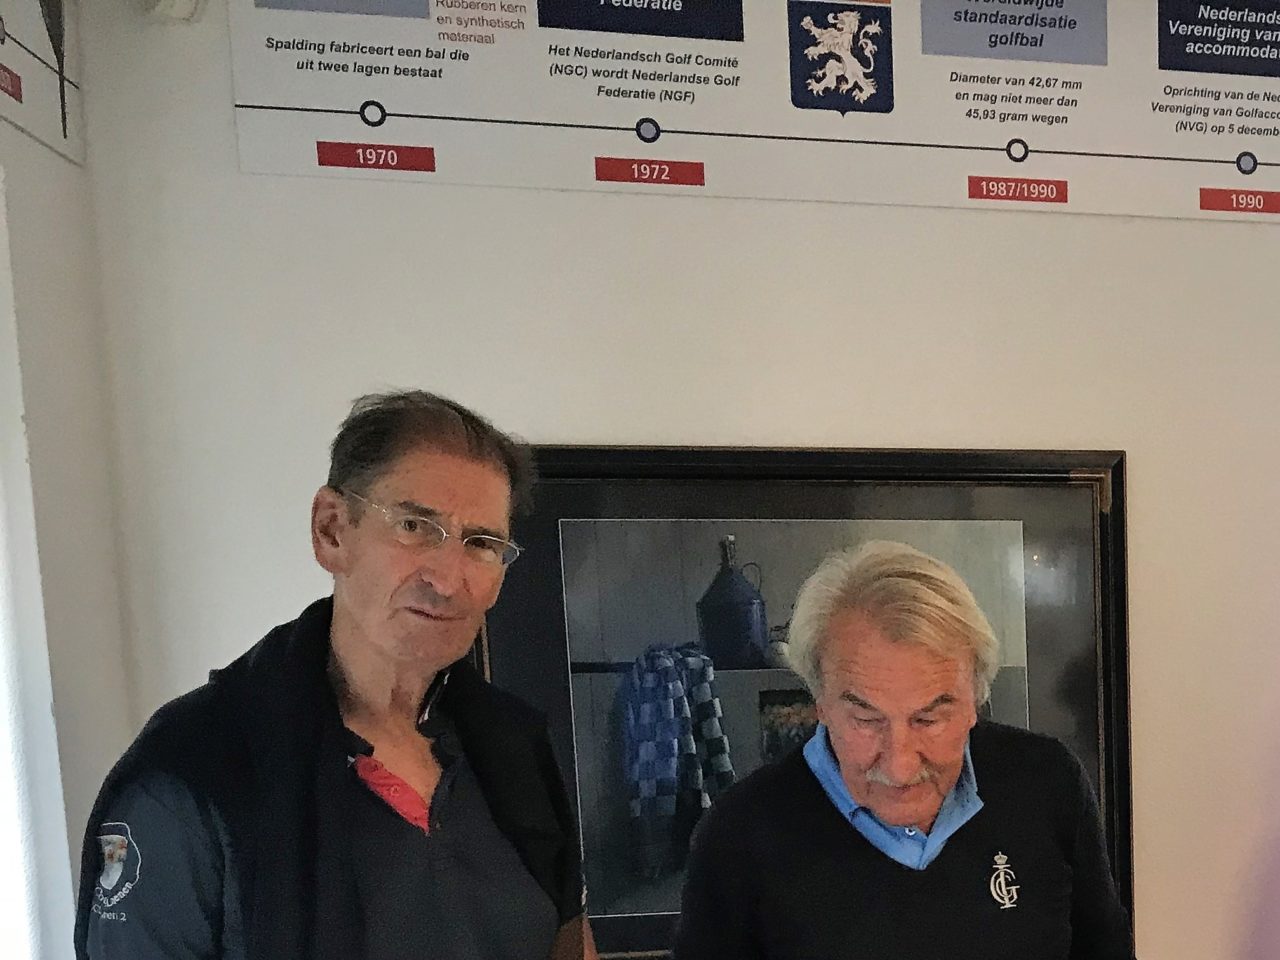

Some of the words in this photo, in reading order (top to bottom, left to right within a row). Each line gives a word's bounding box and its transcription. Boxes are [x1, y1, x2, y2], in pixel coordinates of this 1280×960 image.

[500, 2, 526, 13] kern
[600, 0, 682, 11] ederatie
[437, 15, 452, 24] en
[456, 16, 525, 30] synthetisch
[953, 9, 1077, 30] standaardisatie
[989, 32, 1044, 48] golfbal
[1168, 20, 1250, 42] Vereniging
[265, 37, 326, 54] Spalding
[329, 40, 394, 56] fabriceert
[397, 48, 424, 58] een
[425, 47, 446, 60] bal
[449, 49, 470, 61] die
[548, 45, 570, 56] Het
[574, 46, 661, 63] Nederlandsch
[665, 53, 693, 65] Golf
[296, 59, 314, 70] uit
[318, 61, 349, 73] twee
[353, 59, 390, 76] lagen
[394, 65, 443, 78] bestaat
[549, 64, 587, 79] (NGC)
[592, 67, 628, 80] wordt
[632, 69, 709, 85] Nederlandse
[713, 74, 740, 87] Golf
[950, 72, 1002, 85] Diameter
[1005, 77, 1025, 86] van
[1029, 77, 1058, 89] 42,67
[1061, 81, 1082, 90] mm
[597, 86, 655, 99] Federatie
[660, 89, 695, 104] (NGF)
[956, 91, 969, 101] en
[973, 92, 998, 104] mag
[1001, 92, 1022, 104] niet
[1025, 95, 1054, 105] meer
[1057, 96, 1078, 107] dan
[1163, 85, 1221, 101] Oprichting
[1224, 90, 1244, 100] van
[1246, 91, 1260, 101] de
[965, 109, 996, 120] 45,93
[999, 111, 1028, 122] gram
[1031, 114, 1068, 125] wegen
[1151, 102, 1210, 117] Vereniging
[1213, 107, 1232, 117] van
[1175, 120, 1208, 134] (NVG)
[1211, 124, 1225, 135] op
[1228, 124, 1235, 134] 5
[356, 148, 398, 166] 1970
[630, 163, 671, 181] 1972
[980, 180, 1057, 199] 1987/1990
[1230, 193, 1264, 210] 1990
